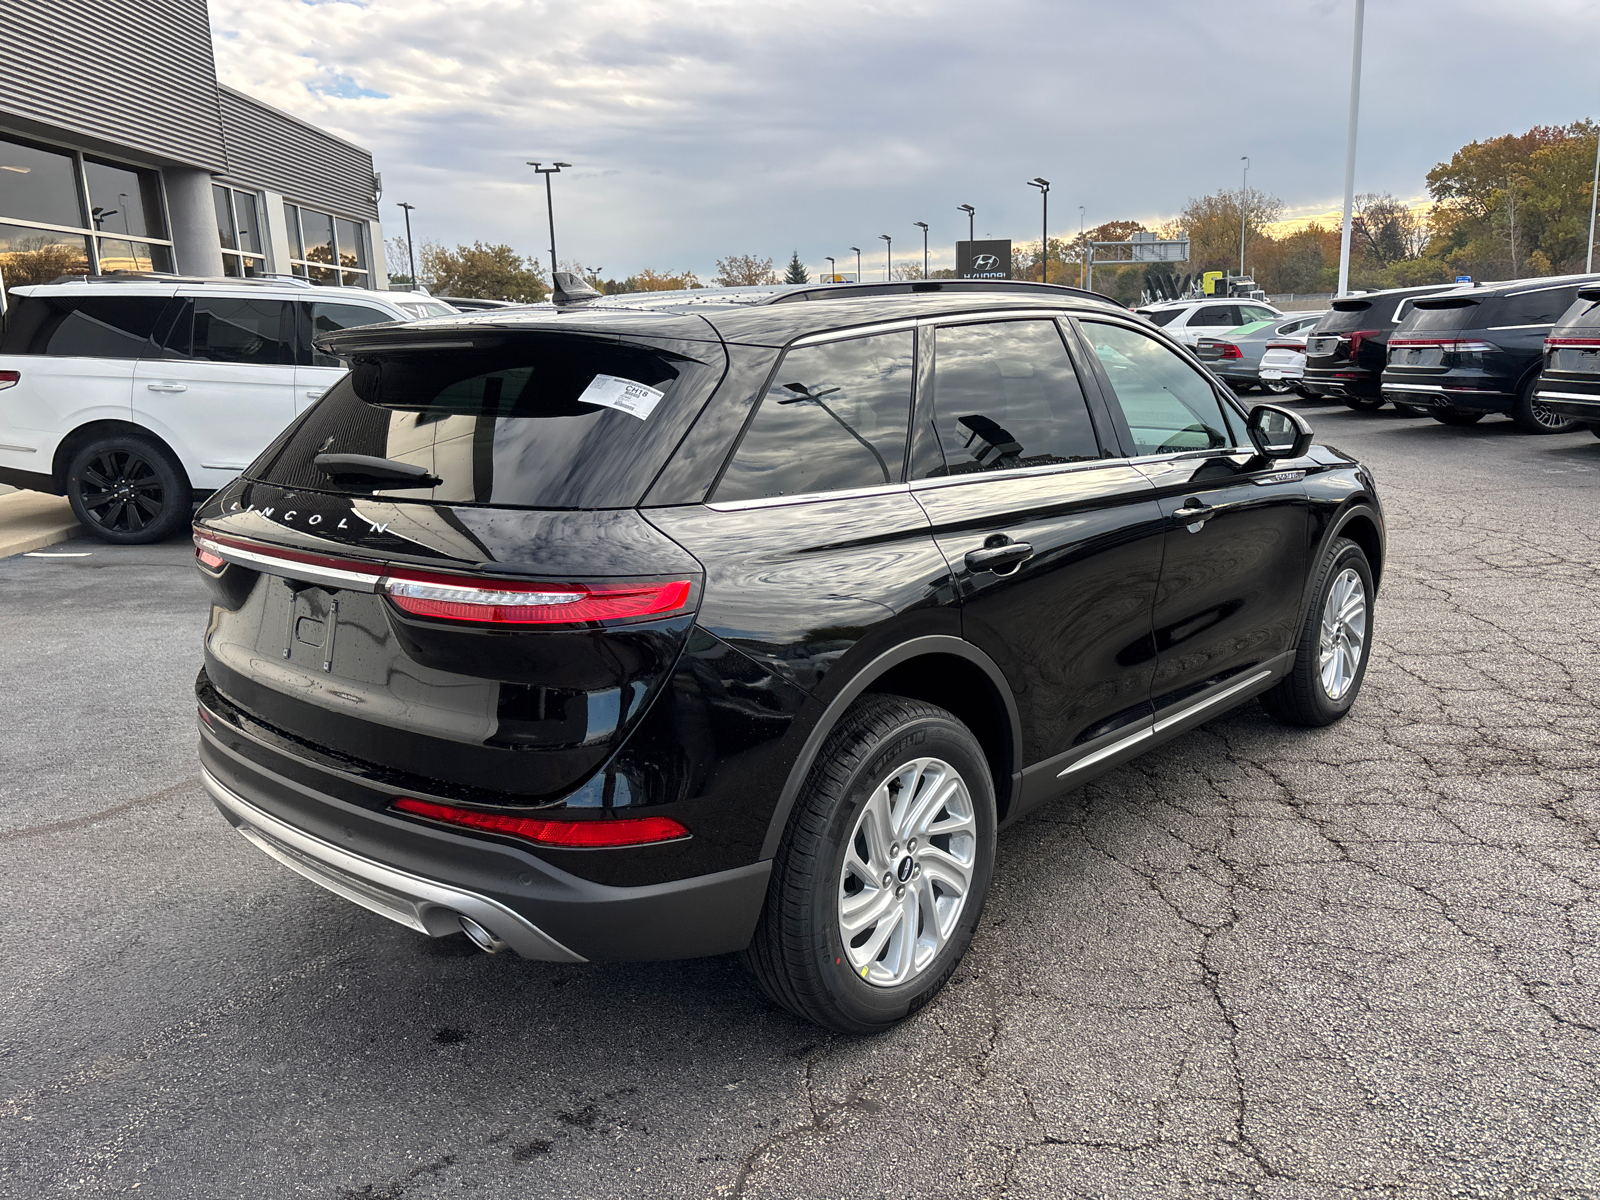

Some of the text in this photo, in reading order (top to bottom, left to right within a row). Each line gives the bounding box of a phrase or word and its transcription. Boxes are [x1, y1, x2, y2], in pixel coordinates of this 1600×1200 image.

[626, 386, 648, 397] CH18
[230, 502, 388, 534] LINCOLN
[873, 730, 925, 774] MICHELIN
